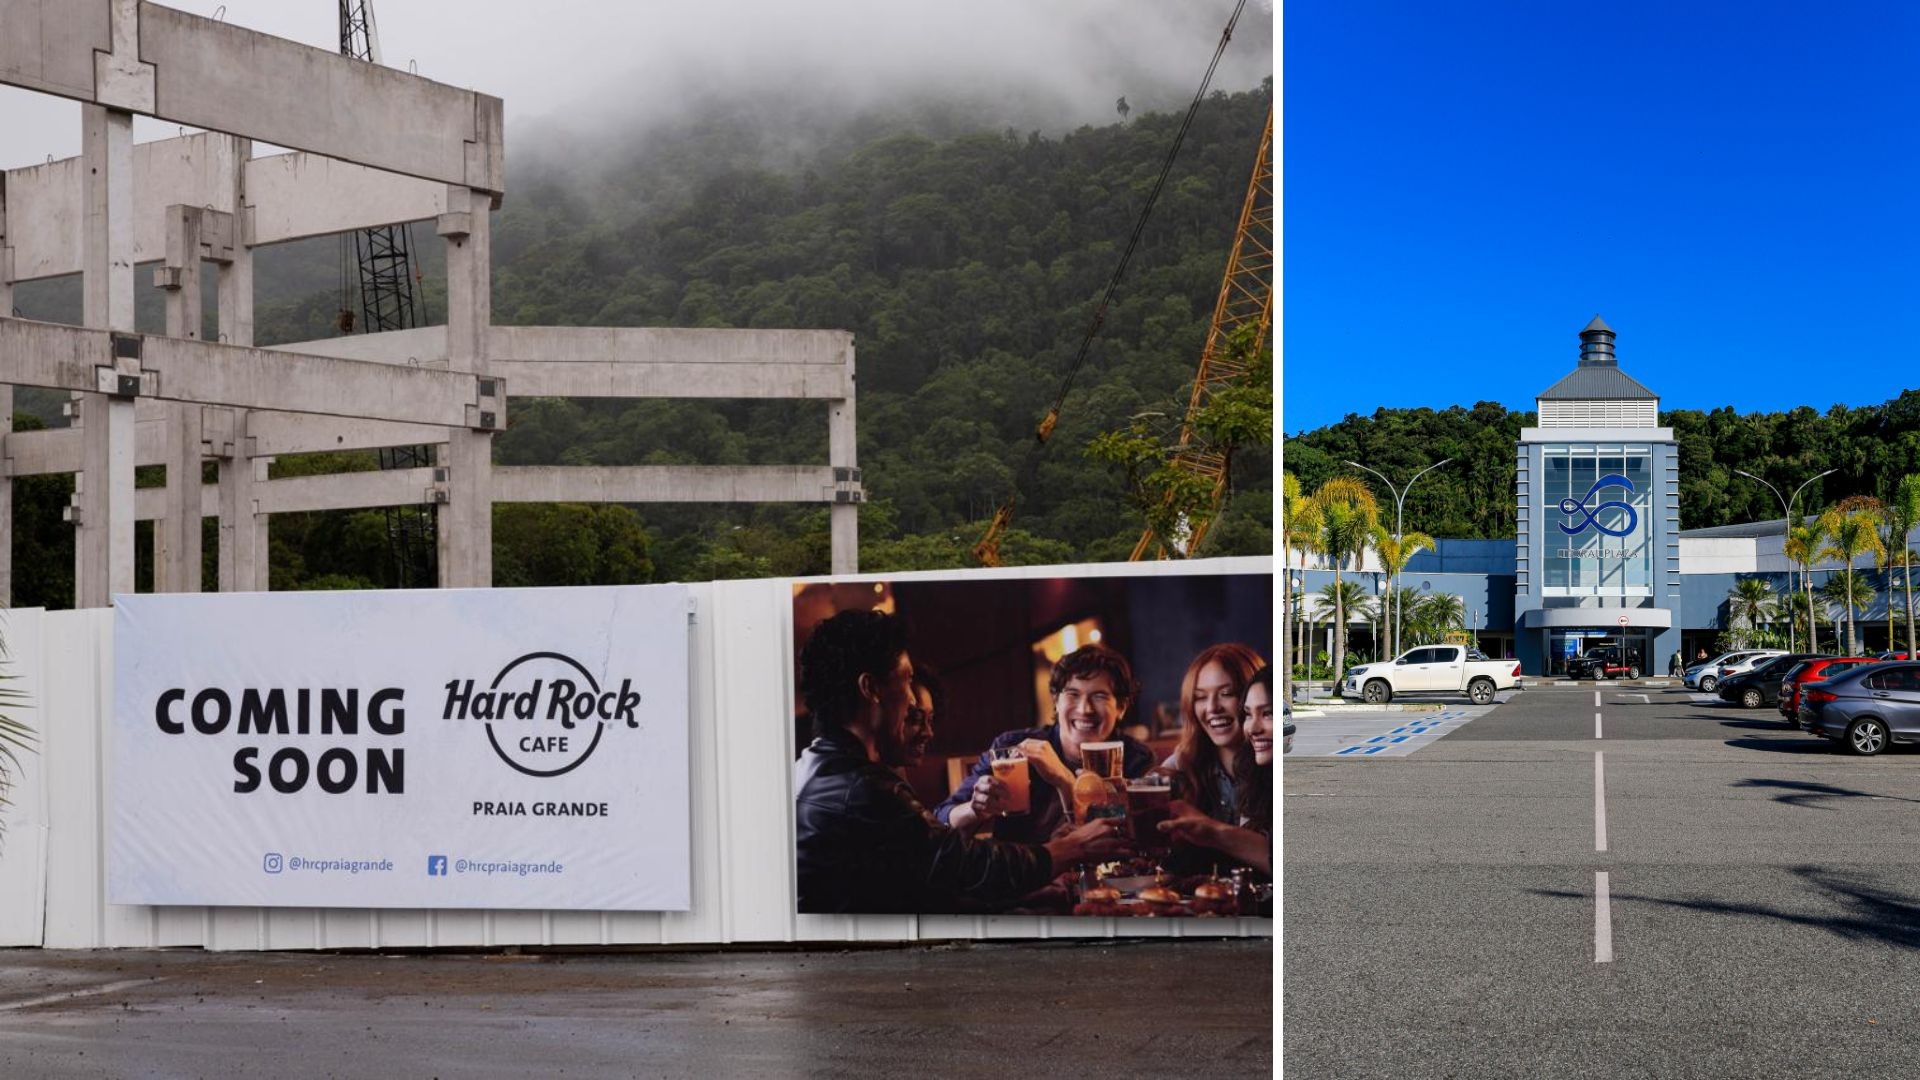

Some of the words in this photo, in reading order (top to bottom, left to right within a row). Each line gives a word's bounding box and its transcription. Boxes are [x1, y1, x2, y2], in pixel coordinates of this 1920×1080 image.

[156, 687, 405, 736] COMING
[442, 678, 543, 721] Hard
[546, 678, 641, 730] Rock
[519, 736, 569, 753] CAFE
[234, 746, 405, 795] SOON
[473, 801, 527, 816] PRAIA
[532, 802, 608, 817] GRANDE
[288, 856, 394, 875] @hrcpraiagrande
[455, 859, 563, 878] @hrcpraiagrande
